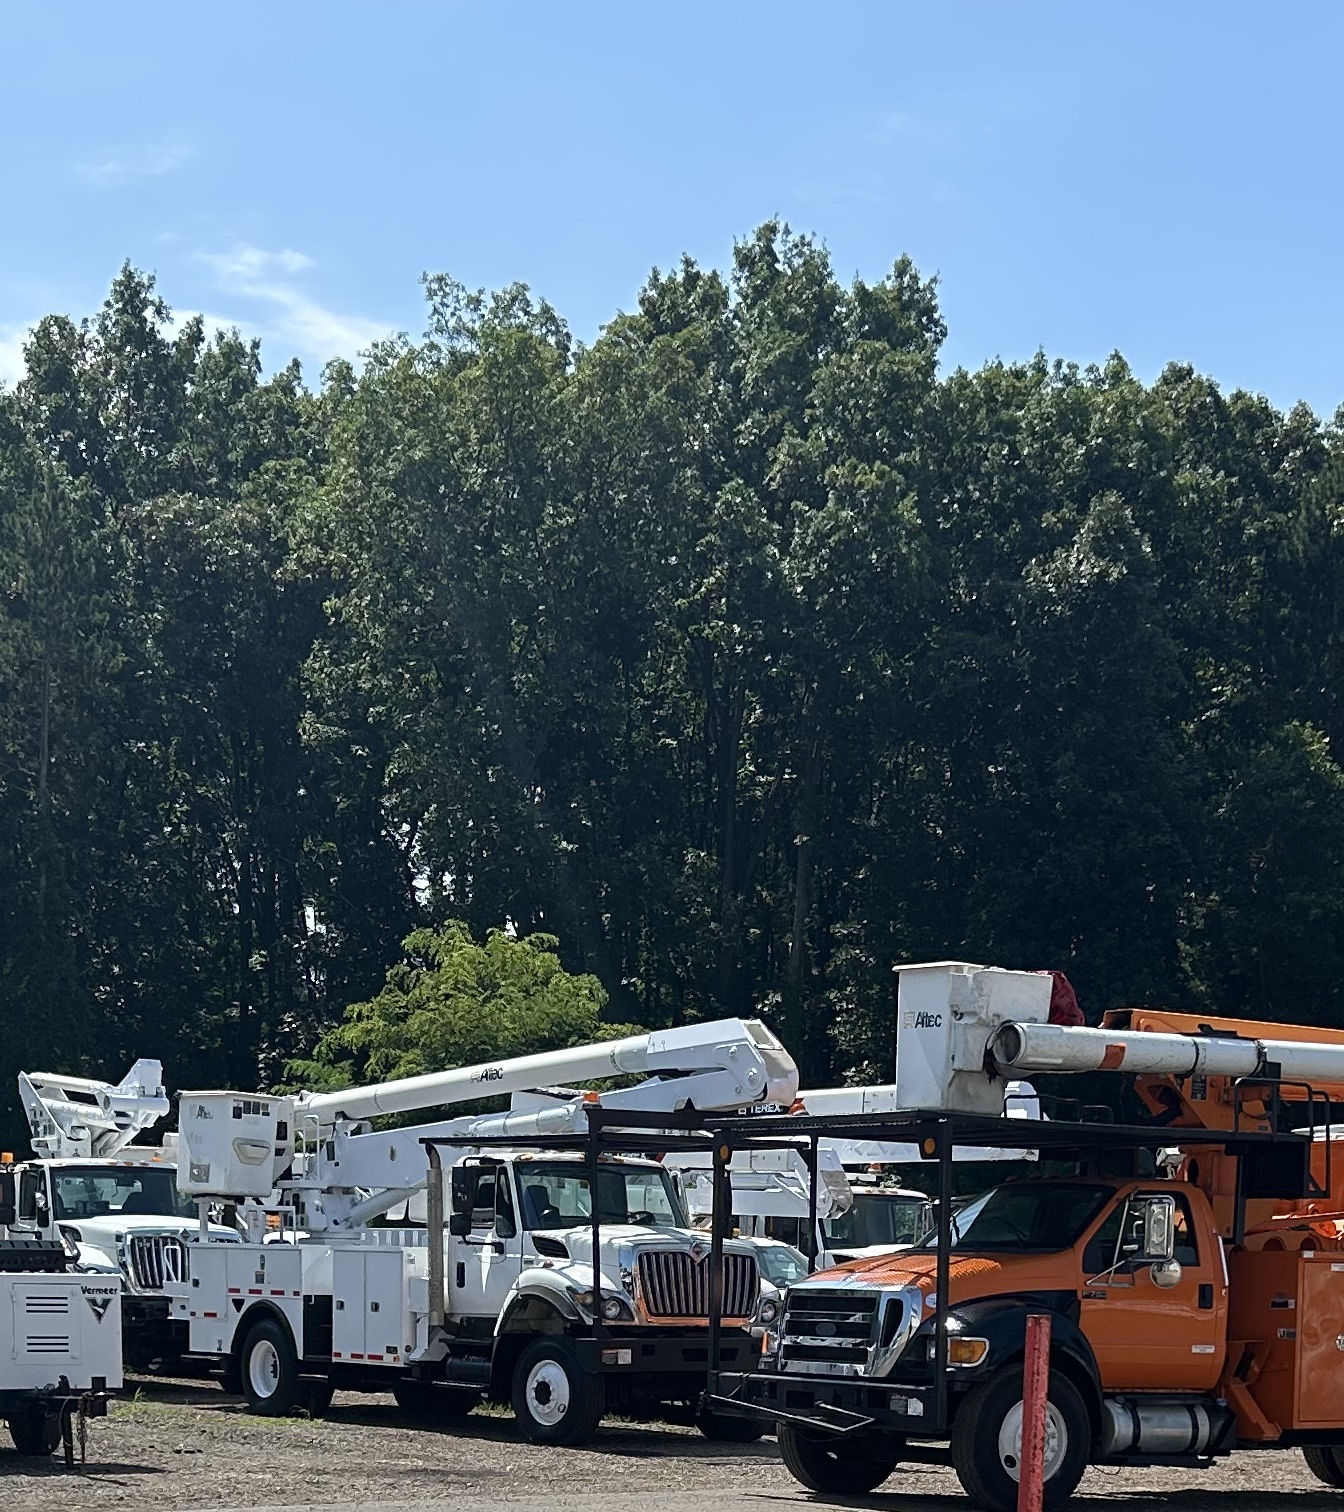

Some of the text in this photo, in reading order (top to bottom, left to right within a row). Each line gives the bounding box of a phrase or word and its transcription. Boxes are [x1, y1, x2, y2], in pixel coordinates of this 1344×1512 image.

[915, 1011, 942, 1028] Altec
[750, 1103, 782, 1114] TEREX
[81, 1285, 118, 1295] Vermeer
